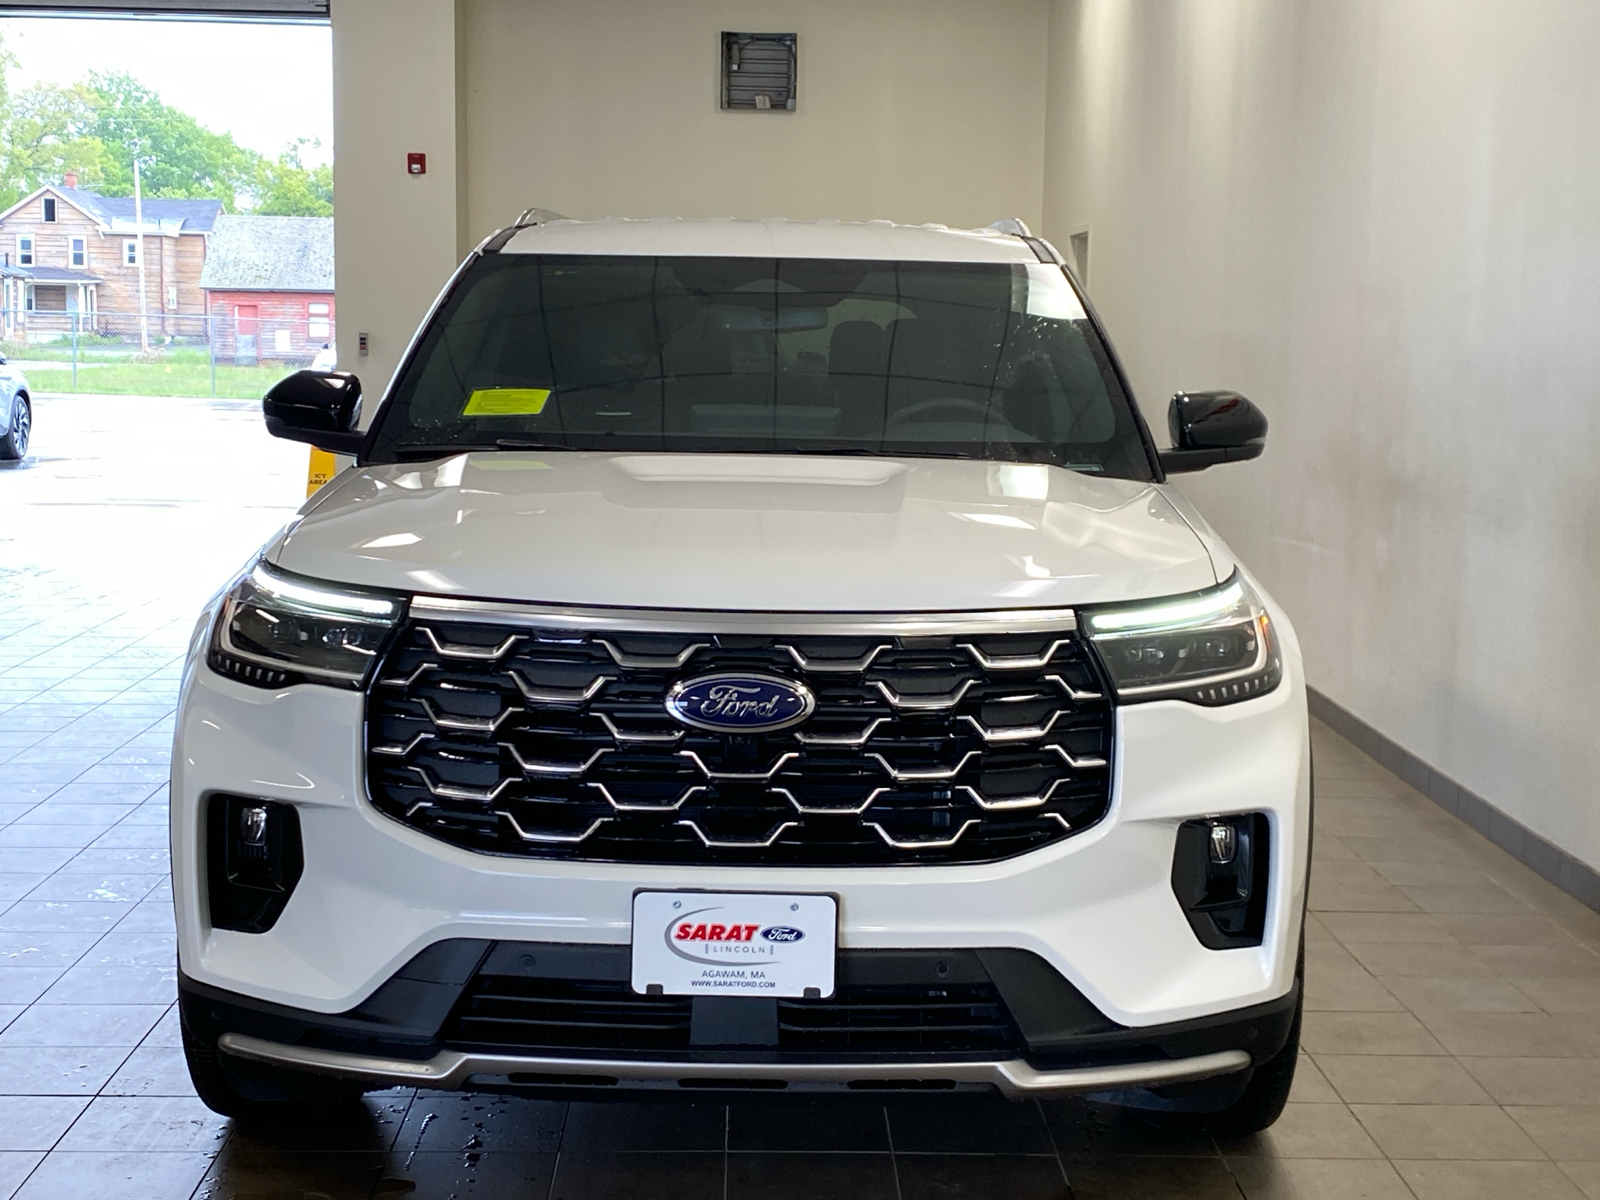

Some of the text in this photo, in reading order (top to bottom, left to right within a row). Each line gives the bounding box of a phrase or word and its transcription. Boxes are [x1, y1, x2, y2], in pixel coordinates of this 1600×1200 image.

[701, 685, 780, 717] Ford
[675, 923, 797, 942] SARAT Ford
[702, 970, 766, 979] AGAWAM, MA
[691, 980, 776, 988] WWW.SARATFORD.COM
